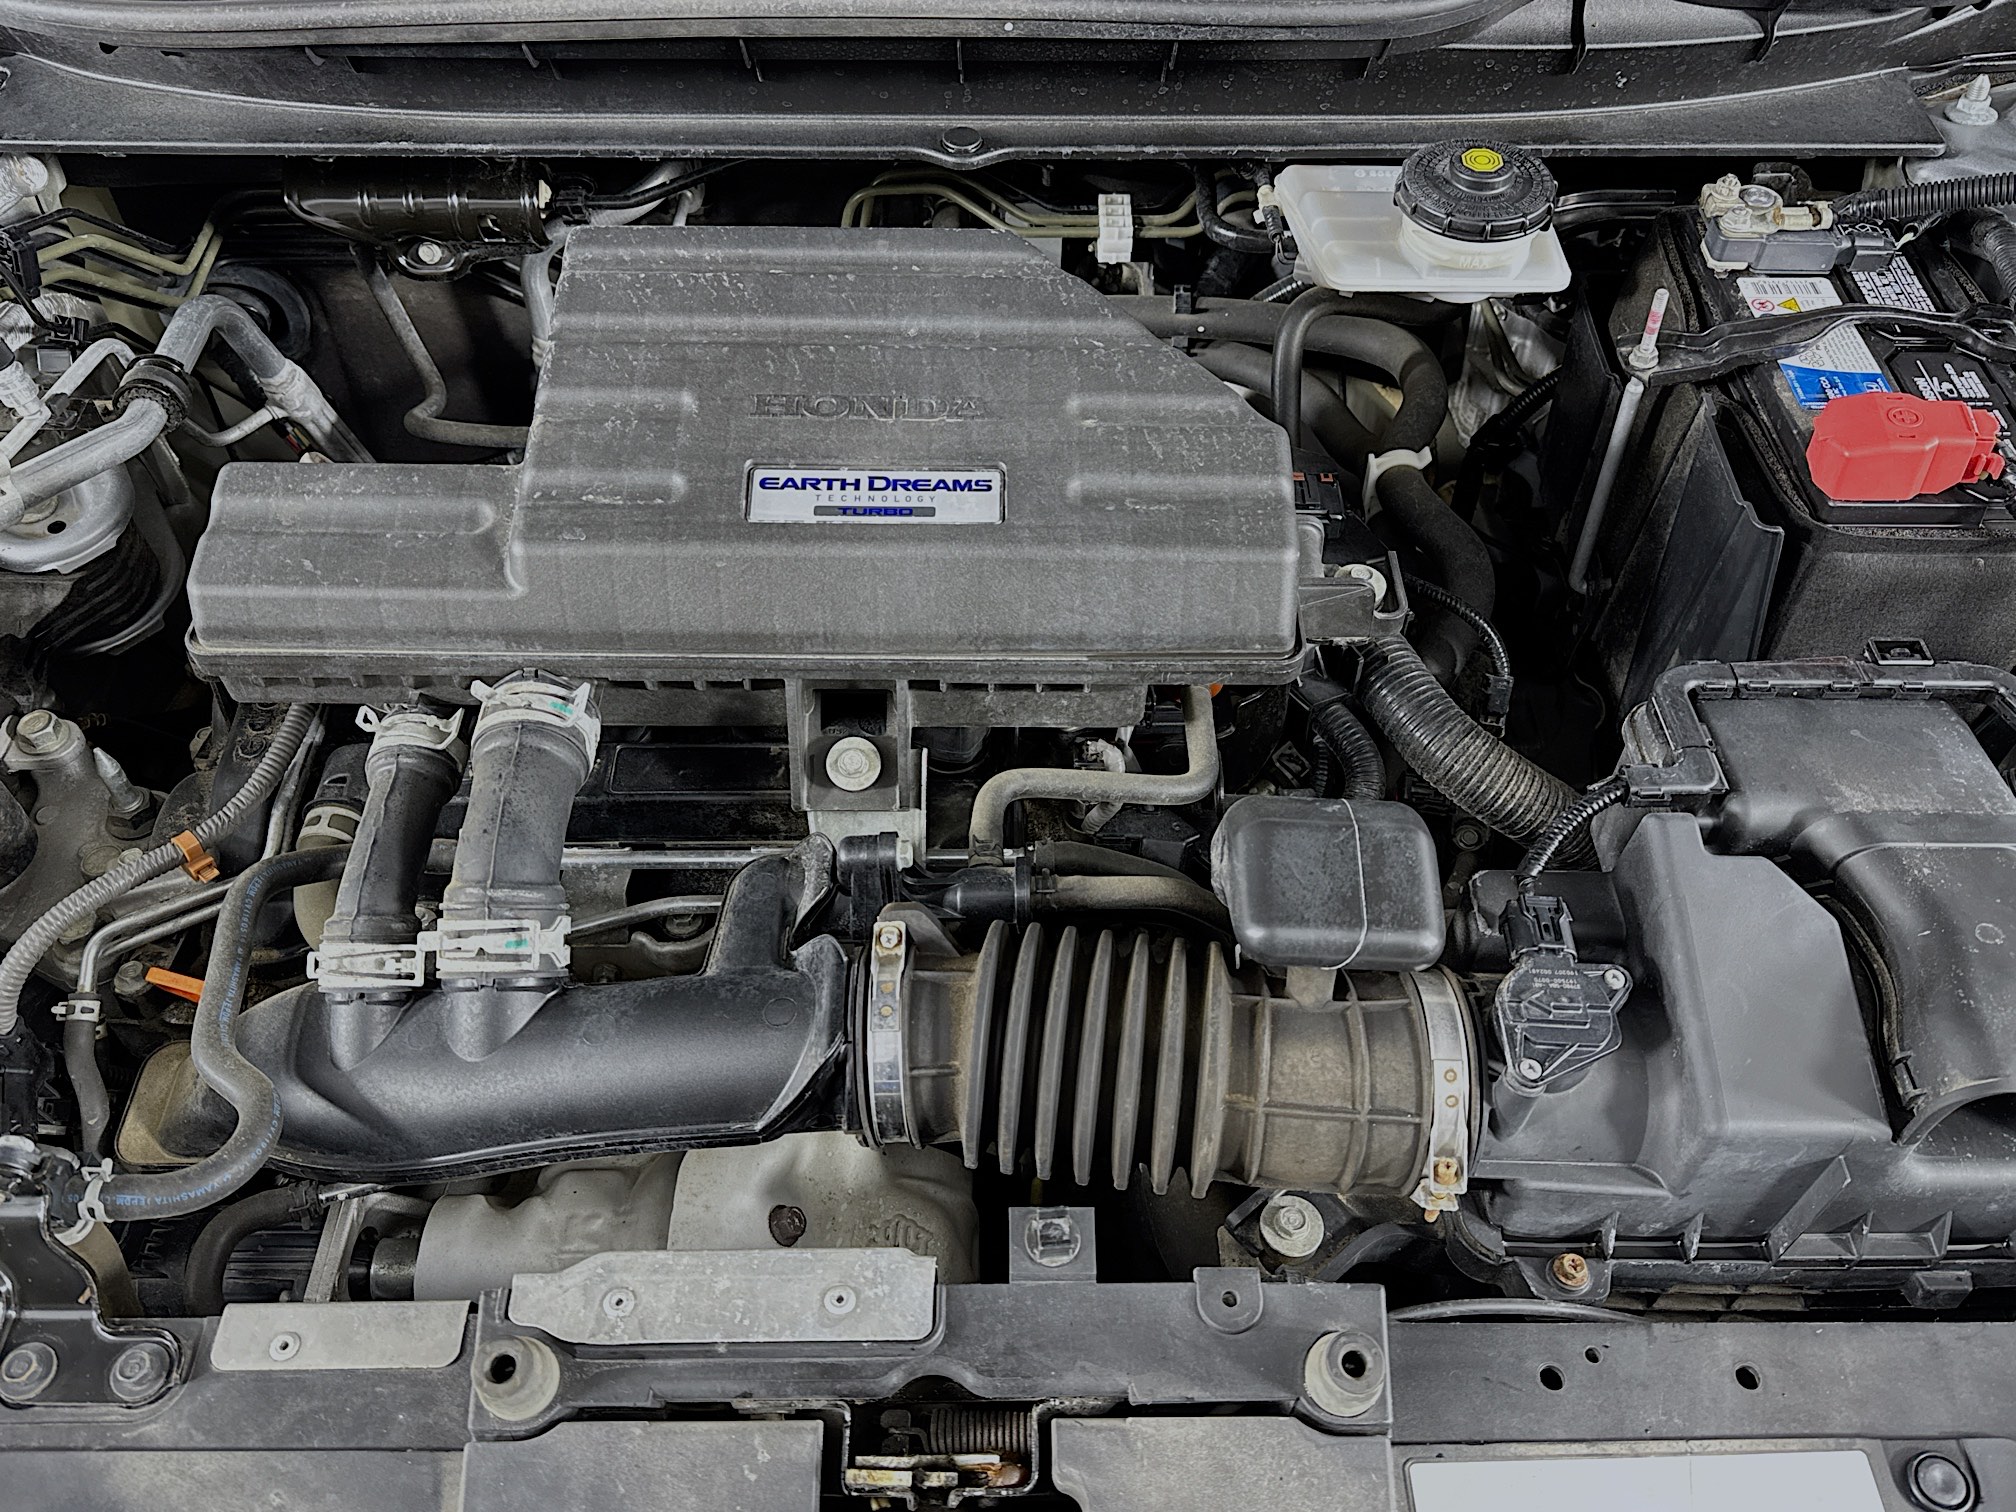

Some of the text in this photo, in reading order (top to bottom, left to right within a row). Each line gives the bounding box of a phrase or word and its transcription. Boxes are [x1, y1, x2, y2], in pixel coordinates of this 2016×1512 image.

[1369, 169, 1401, 178] BOSC
[1459, 255, 1490, 269] MAX
[749, 393, 990, 421] HONDA
[759, 475, 993, 492] EARTH DREAMS
[815, 494, 936, 503] TECHNOLOGY
[837, 507, 914, 517] TURBO
[228, 954, 244, 999] YAMASHITA
[154, 1181, 219, 1206] YAMASHITA
